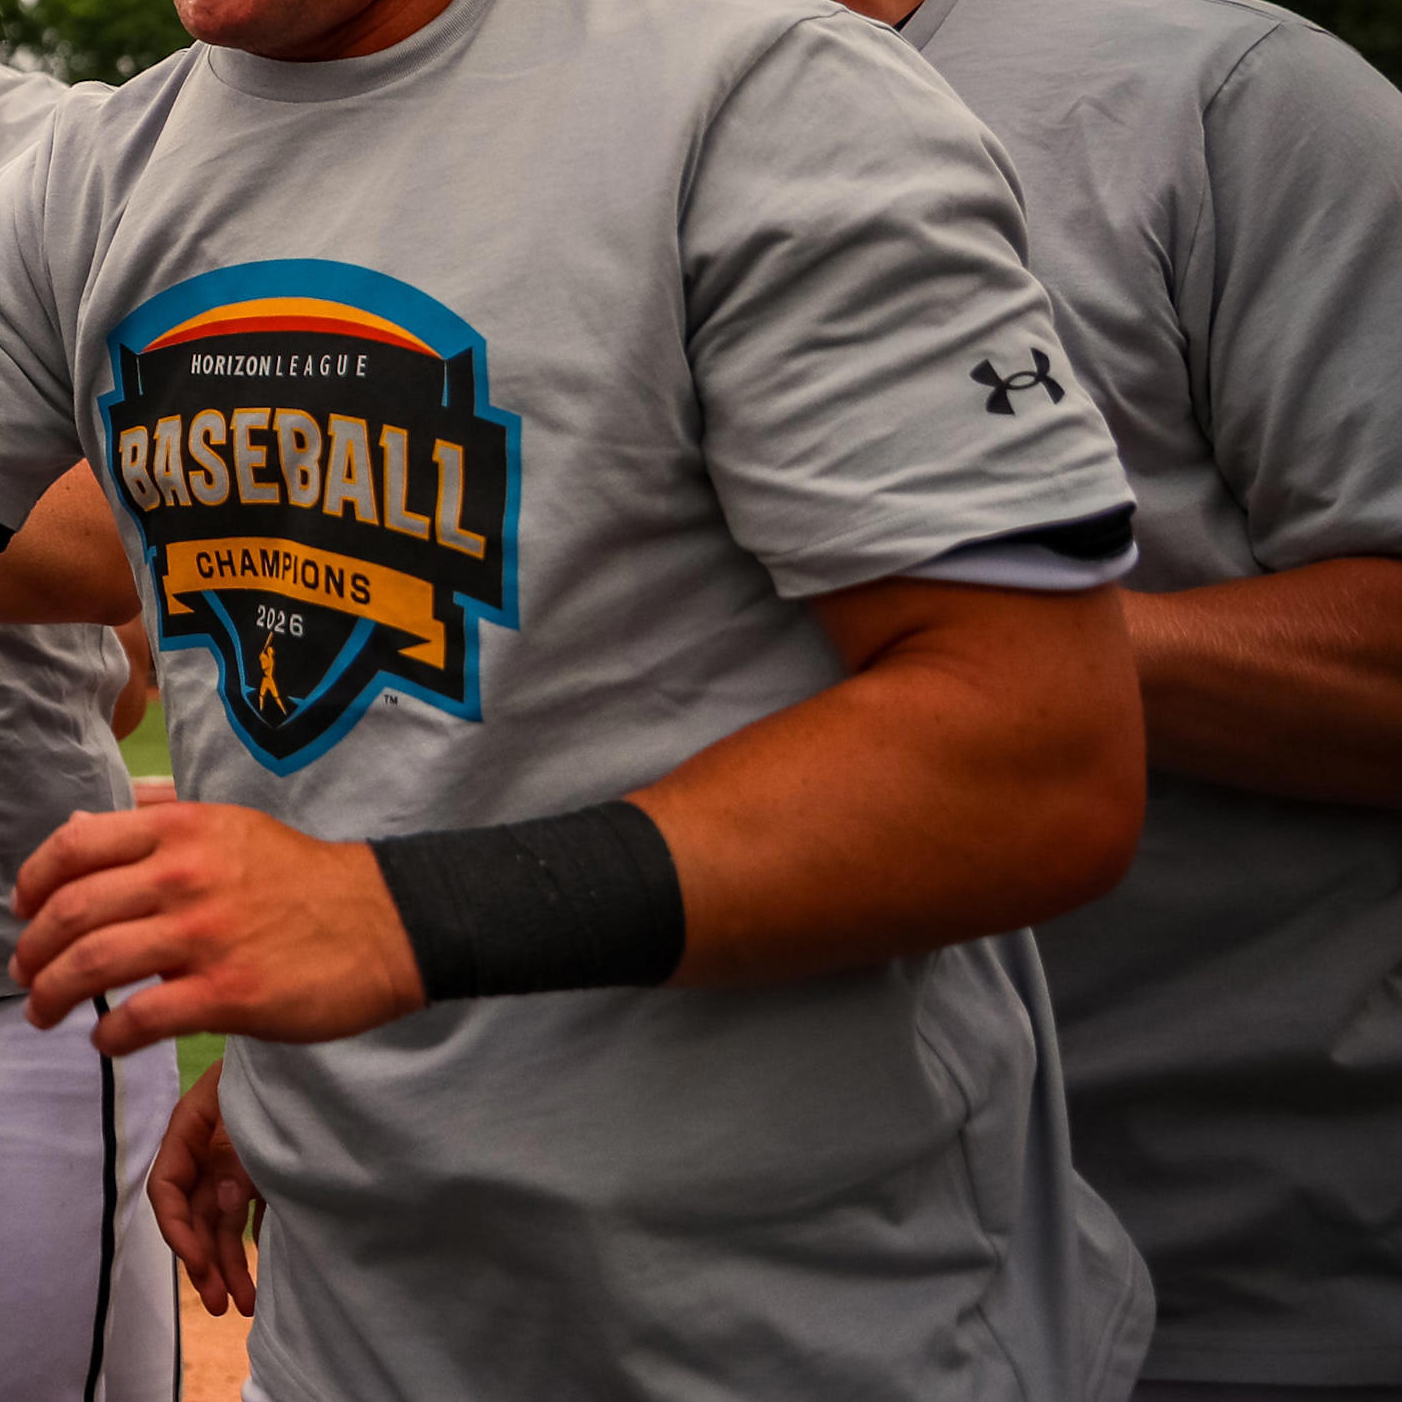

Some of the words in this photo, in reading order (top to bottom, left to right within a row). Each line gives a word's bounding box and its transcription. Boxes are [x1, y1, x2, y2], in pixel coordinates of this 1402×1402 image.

[190, 353, 271, 377] HORIZON
[275, 354, 368, 378] LEAGUE
[118, 406, 487, 561] BASEBALL
[195, 551, 371, 605] CHAMPIONS
[255, 604, 305, 638] 2026
